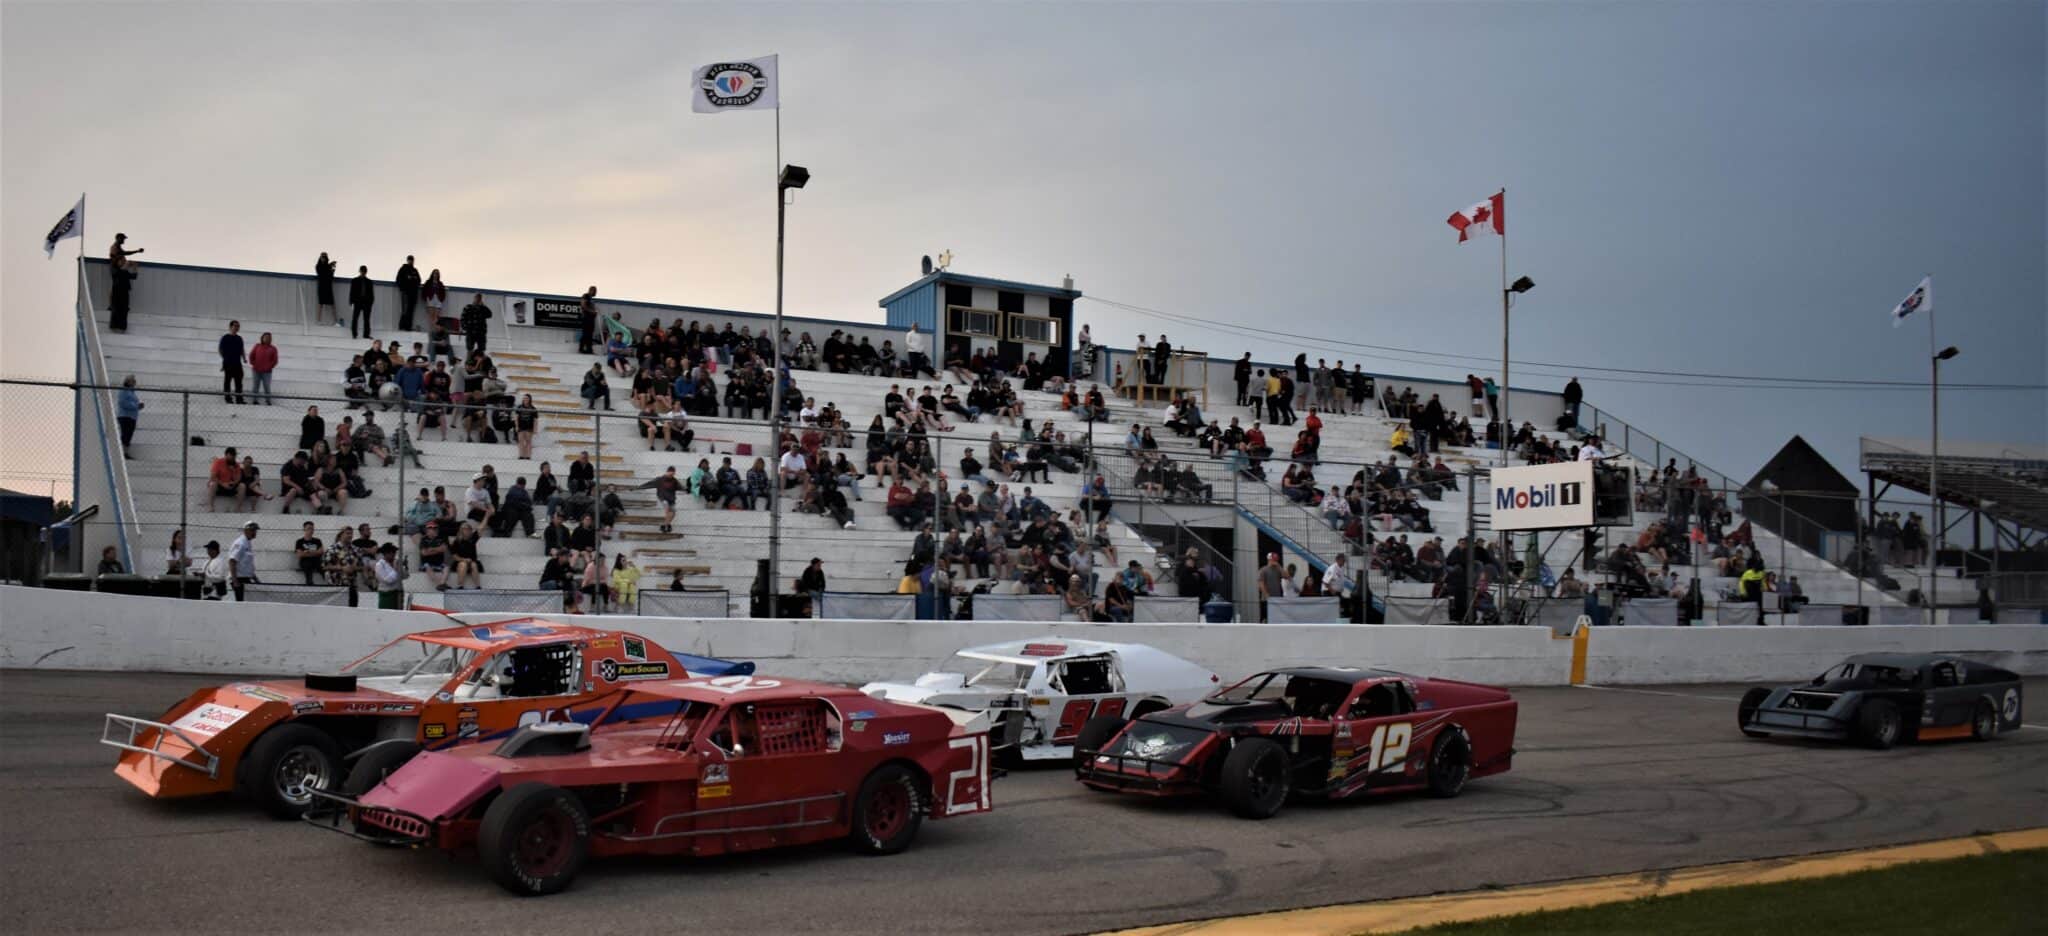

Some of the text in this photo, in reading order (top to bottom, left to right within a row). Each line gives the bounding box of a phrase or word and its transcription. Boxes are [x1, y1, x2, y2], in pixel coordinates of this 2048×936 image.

[537, 303, 558, 312] DON
[1496, 482, 1577, 510] Mobil 1
[1367, 722, 1413, 774] 12
[946, 735, 991, 815] 21
